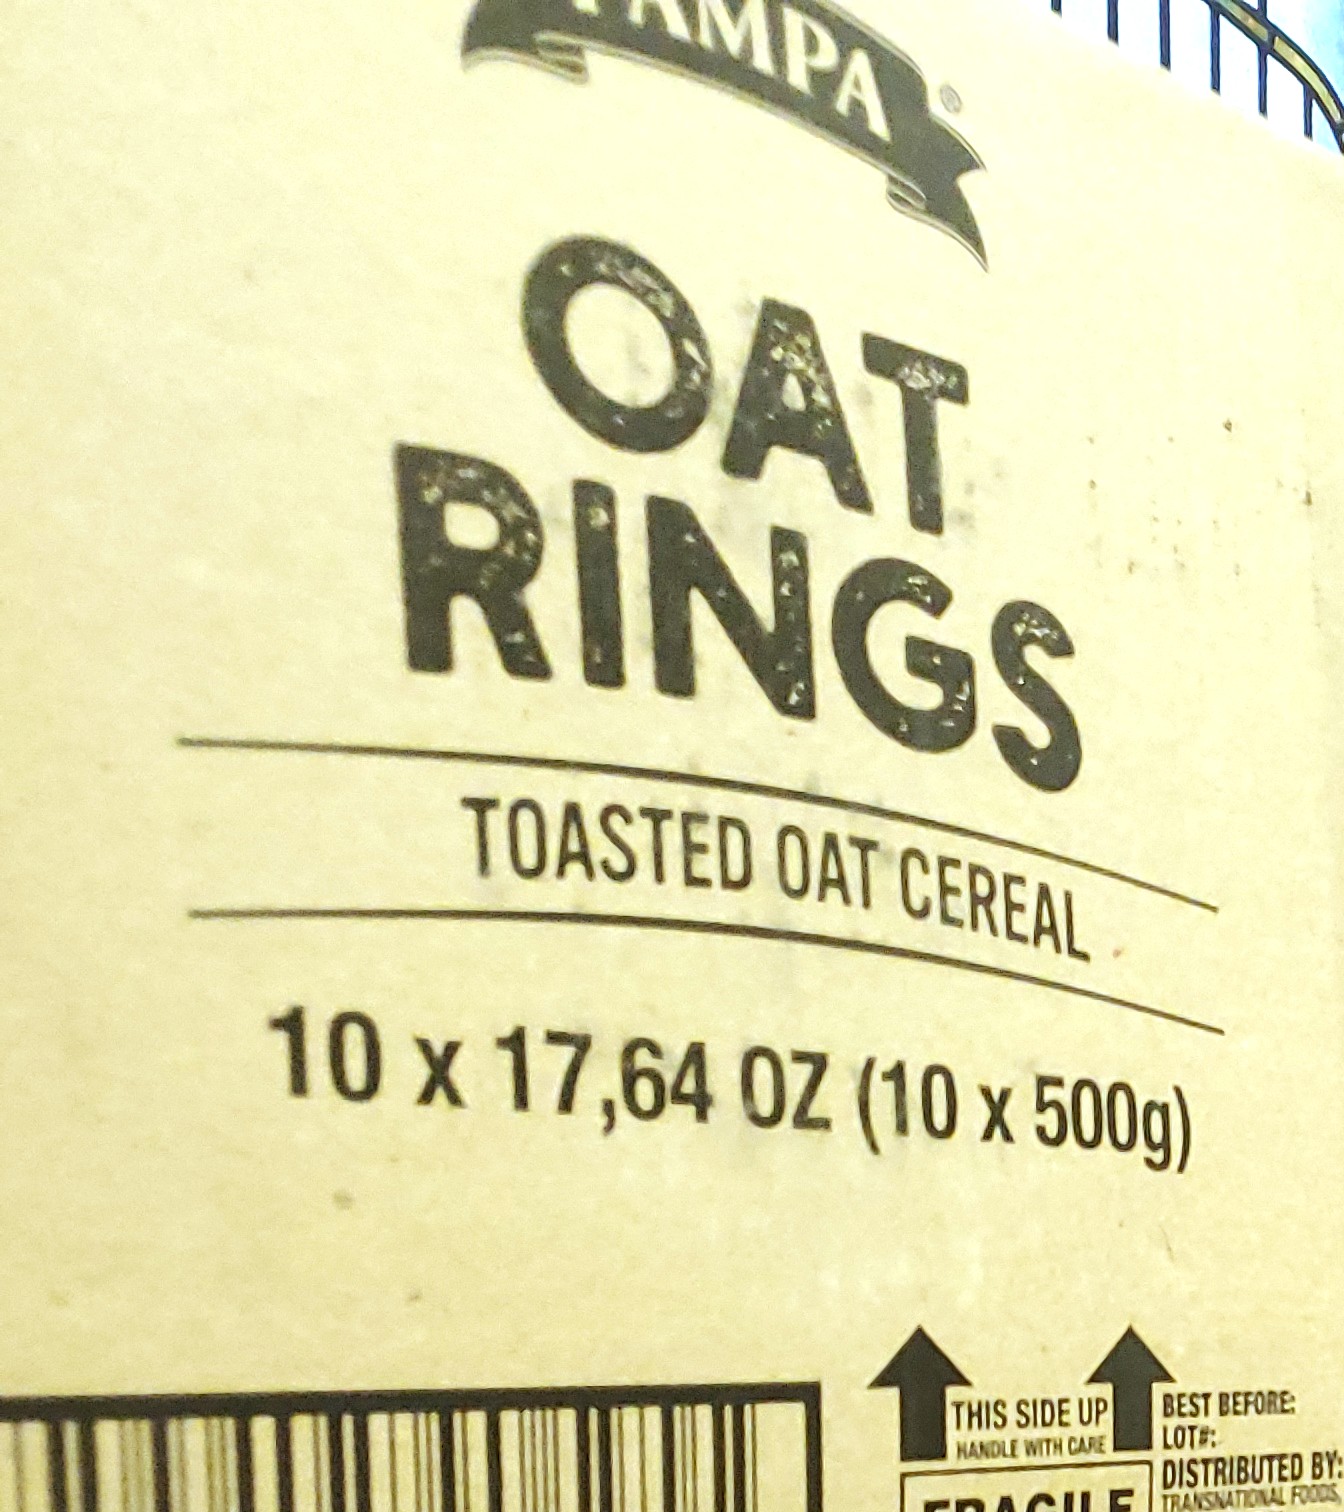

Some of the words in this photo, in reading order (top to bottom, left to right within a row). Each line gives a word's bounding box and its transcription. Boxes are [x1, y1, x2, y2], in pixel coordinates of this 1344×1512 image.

[519, 233, 970, 534] OAT
[395, 442, 1083, 791] RINGS
[462, 796, 753, 892] TOASTED
[777, 823, 879, 911] OAT
[901, 846, 1090, 961] CEREAL
[267, 1006, 382, 1102] 10
[416, 1036, 465, 1109] x
[495, 1028, 712, 1137] 17,64
[742, 1046, 830, 1131] OZ
[858, 1057, 957, 1152] (10
[980, 1085, 1017, 1144] x
[1035, 1077, 1191, 1173] 500g)
[952, 1398, 1007, 1431] THIS
[1016, 1398, 1070, 1429] SIDE
[1079, 1398, 1107, 1423] UP
[1162, 1392, 1210, 1418] BEST
[1218, 1391, 1295, 1416] BEFORE:
[957, 1438, 1019, 1461] HANDLE
[1025, 1437, 1063, 1456] WITH
[1068, 1435, 1106, 1455] CARE
[1162, 1425, 1216, 1450] LOT#:
[1161, 1454, 1303, 1490] DISTRIBUTED
[1310, 1451, 1343, 1478] BY:
[1290, 1483, 1340, 1503] FOODS,
